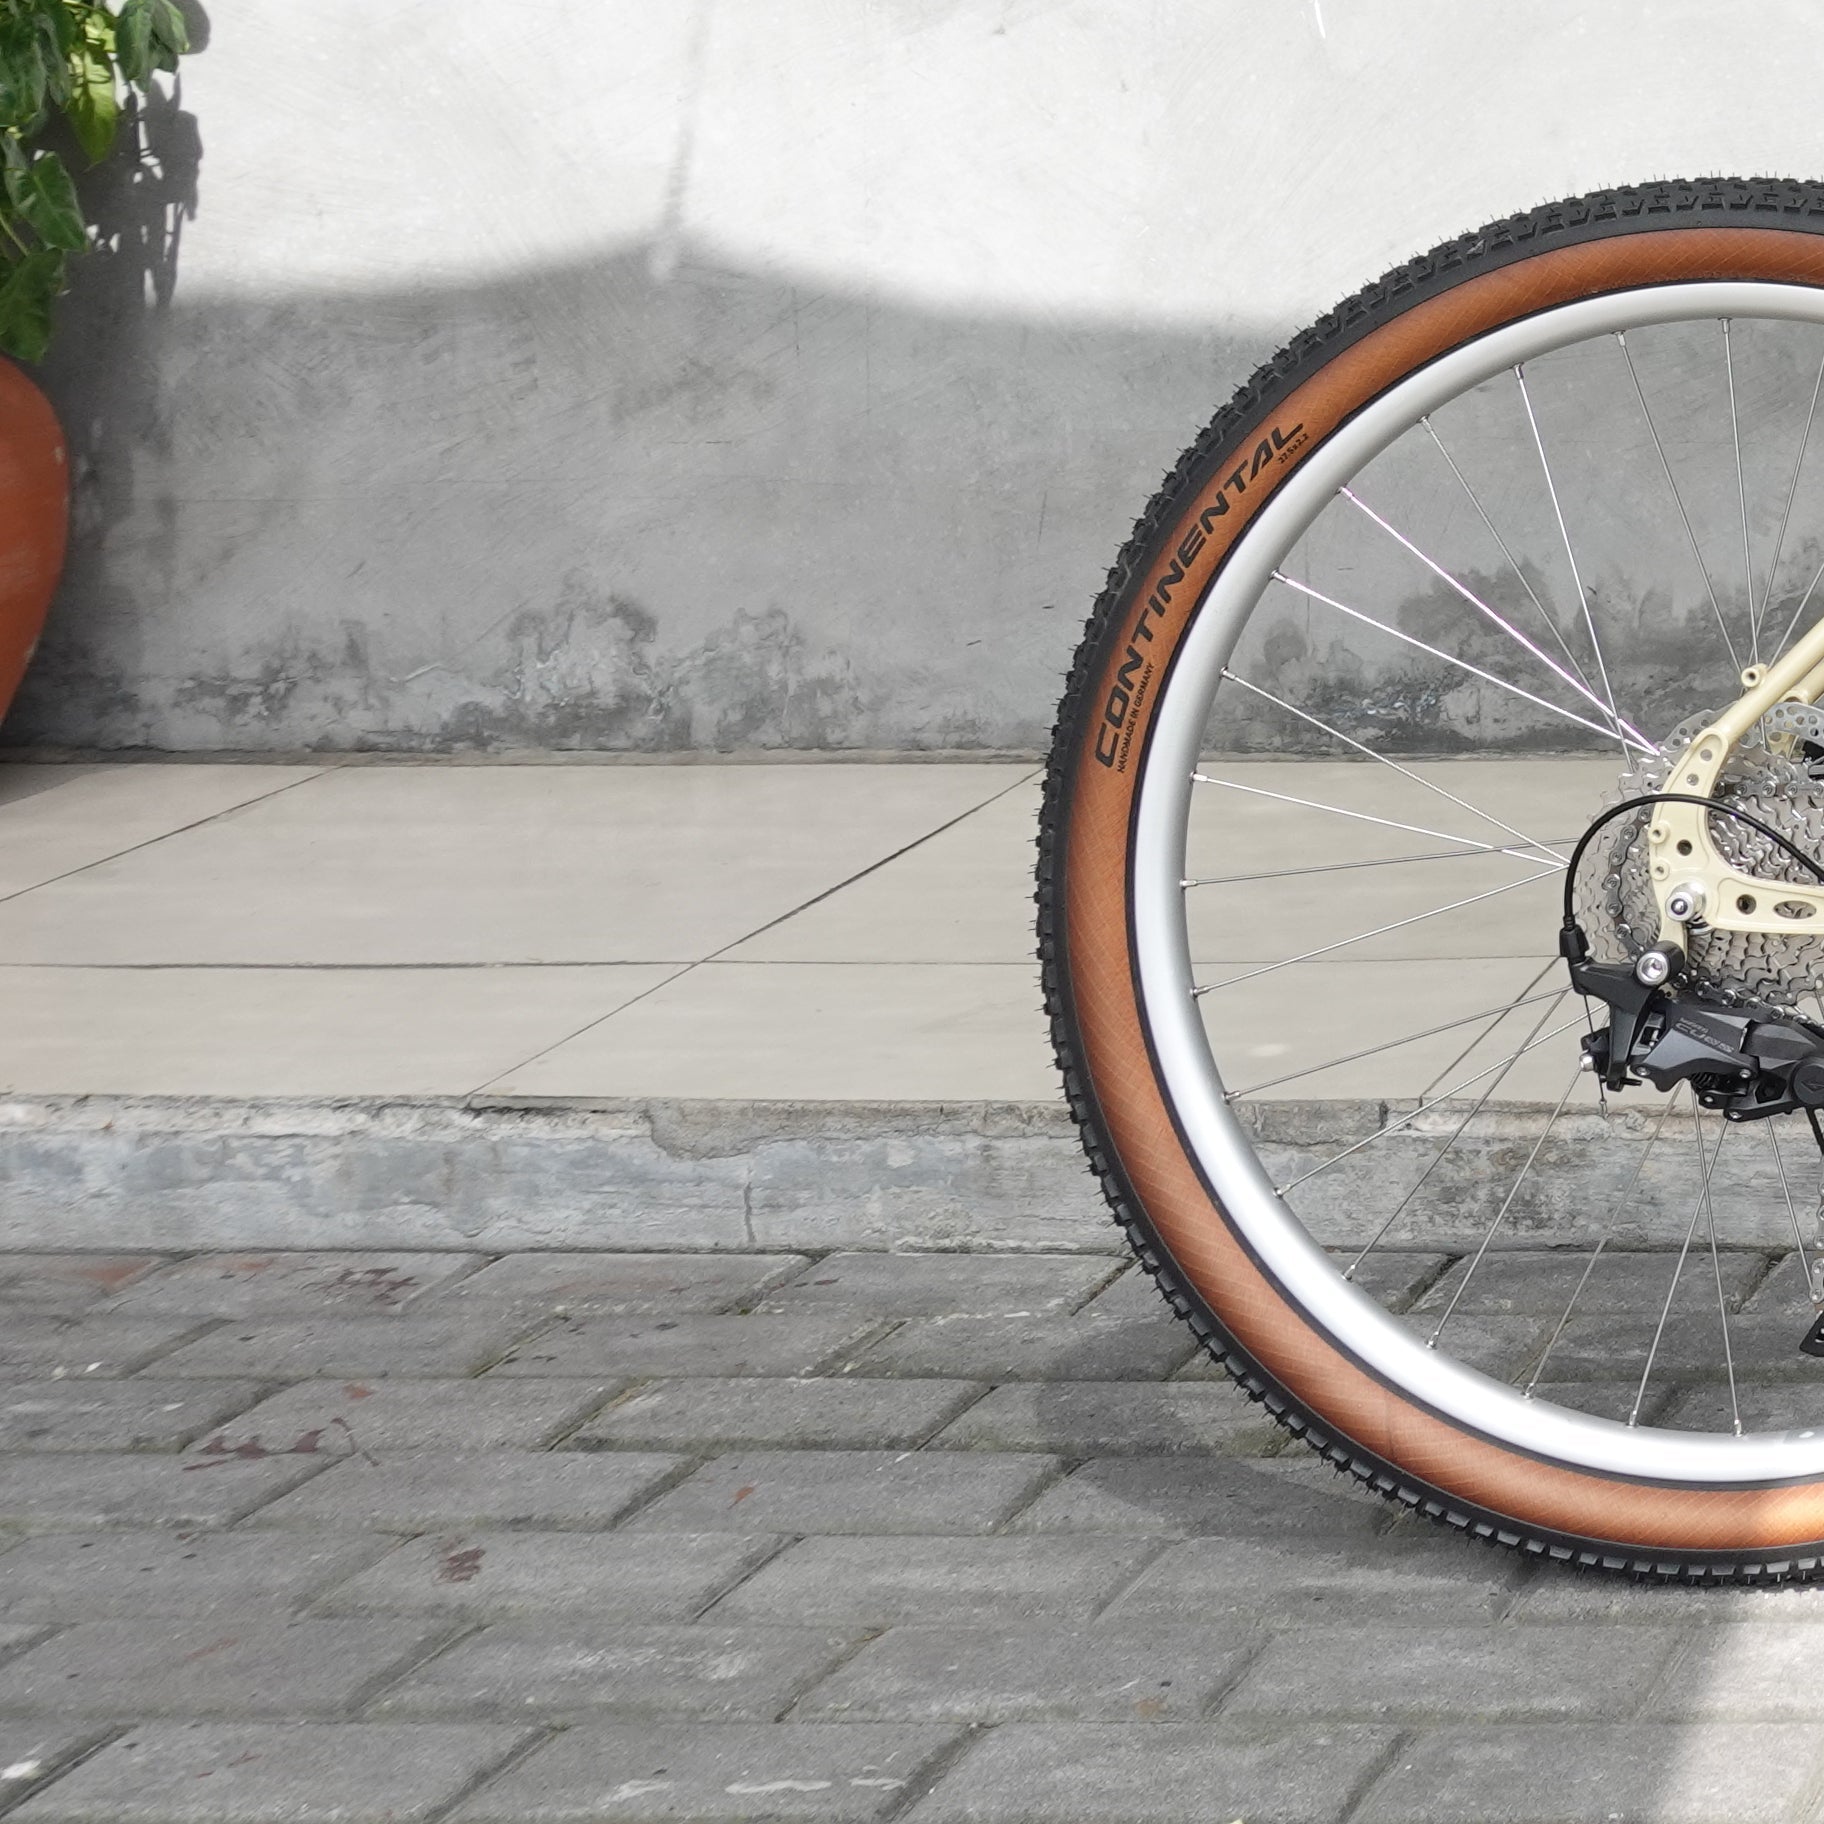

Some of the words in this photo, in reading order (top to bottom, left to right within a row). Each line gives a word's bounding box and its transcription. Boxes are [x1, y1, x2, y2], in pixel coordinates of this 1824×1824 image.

[1095, 422, 1304, 769] CONTINENTAL
[1134, 662, 1155, 709] GERMANY
[1130, 708, 1140, 720] IN
[1117, 720, 1137, 774] HANDMADE
